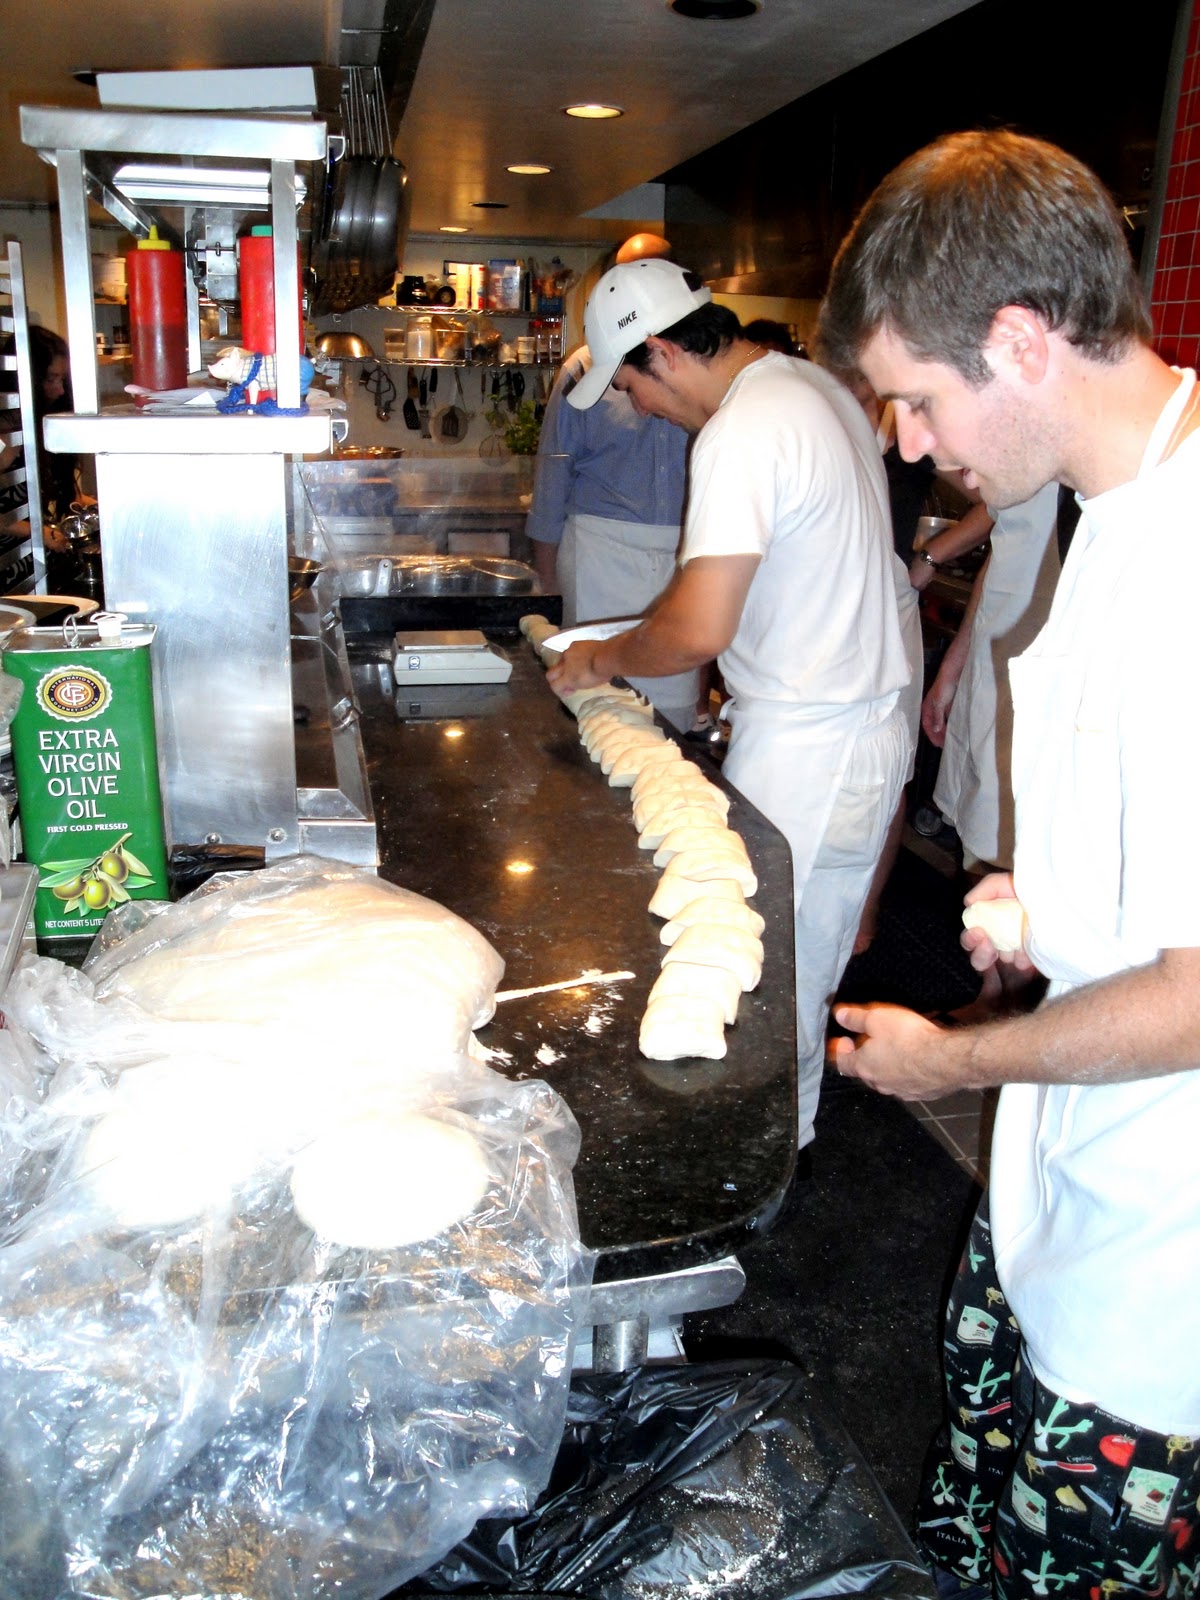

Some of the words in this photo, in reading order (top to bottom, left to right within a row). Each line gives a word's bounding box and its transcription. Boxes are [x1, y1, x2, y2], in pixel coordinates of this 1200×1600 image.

[617, 310, 637, 330] NIKE
[50, 676, 97, 692] INTERNATIONAL
[50, 697, 78, 712] GOURMET
[80, 697, 99, 711] FOODS
[38, 728, 119, 750] EXTRA
[38, 751, 122, 774] VIRGIN
[47, 775, 119, 797] OLIVE
[66, 799, 106, 819] OIL
[69, 824, 93, 832] COLD
[94, 822, 128, 831] PRESSED
[45, 920, 57, 928] NET
[57, 919, 83, 928] CONTENT
[936, 1531, 967, 1546] ITALIA
[1062, 1533, 1095, 1549] ITALIA
